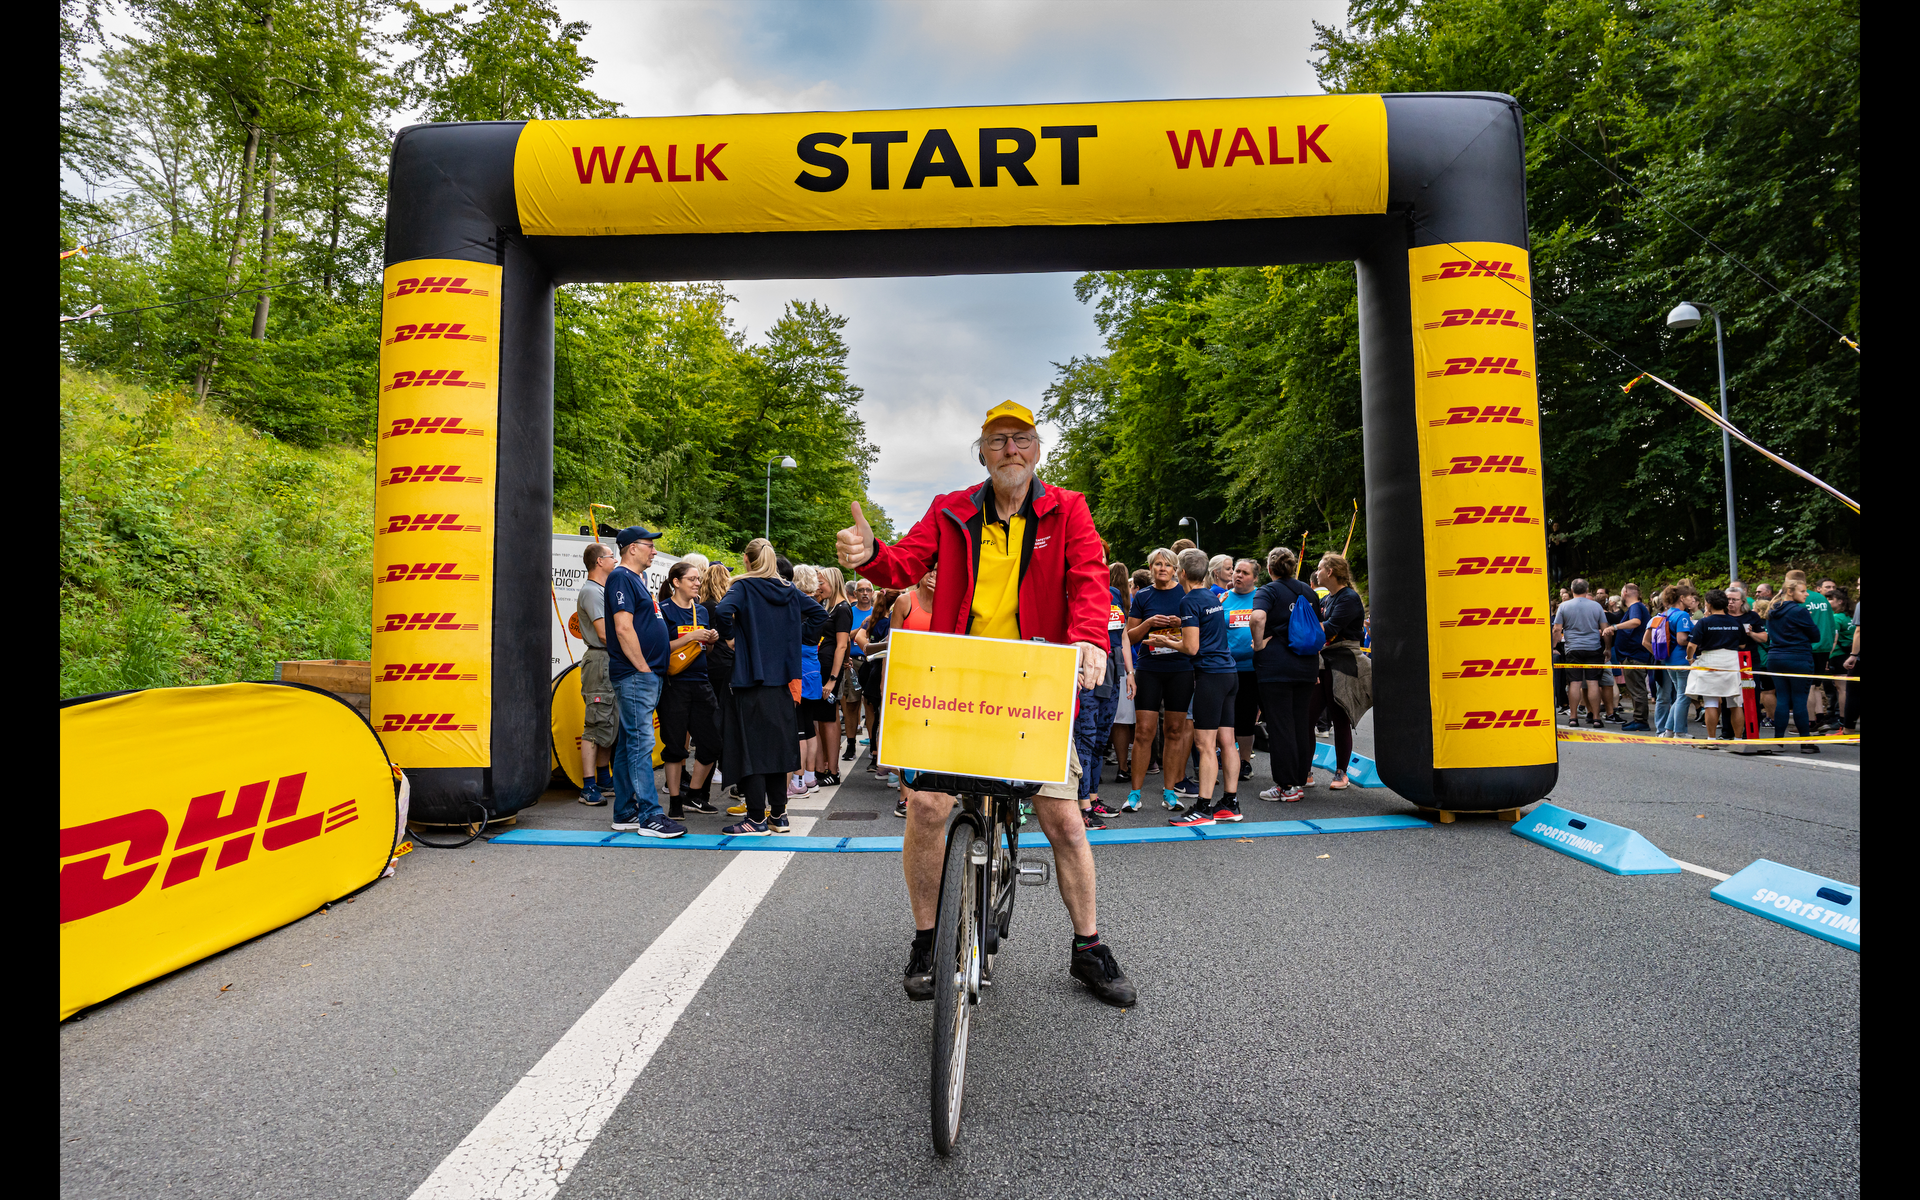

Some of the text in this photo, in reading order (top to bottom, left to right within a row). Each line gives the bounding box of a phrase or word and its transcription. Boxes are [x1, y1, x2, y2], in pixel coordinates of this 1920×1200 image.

[571, 123, 1333, 193] WALK START WALK
[1438, 260, 1517, 280] DHL
[396, 276, 473, 297] DHL
[1440, 308, 1520, 328] DHL
[394, 323, 471, 344] DHL
[1444, 356, 1523, 377] DHL
[392, 369, 470, 390] DHL
[1446, 405, 1526, 426] DHL
[390, 417, 468, 438] DHL
[388, 465, 467, 485] DHL
[1449, 455, 1529, 475] DHL
[387, 513, 465, 534] DHL
[1452, 505, 1532, 526] DHL
[385, 562, 463, 583] DHL
[1455, 556, 1535, 576] DHL
[384, 612, 462, 632] DHL
[1457, 606, 1537, 627] DHL
[383, 662, 461, 682] DHL
[1460, 657, 1540, 679] DHL
[889, 692, 1064, 722] Fejebladet for walker
[382, 713, 461, 733] DHL
[1462, 708, 1543, 730] DHL
[60, 771, 325, 925] DHL
[1532, 822, 1604, 855] SPORTSTIMING
[1751, 888, 1860, 936] SPORTSTIM
